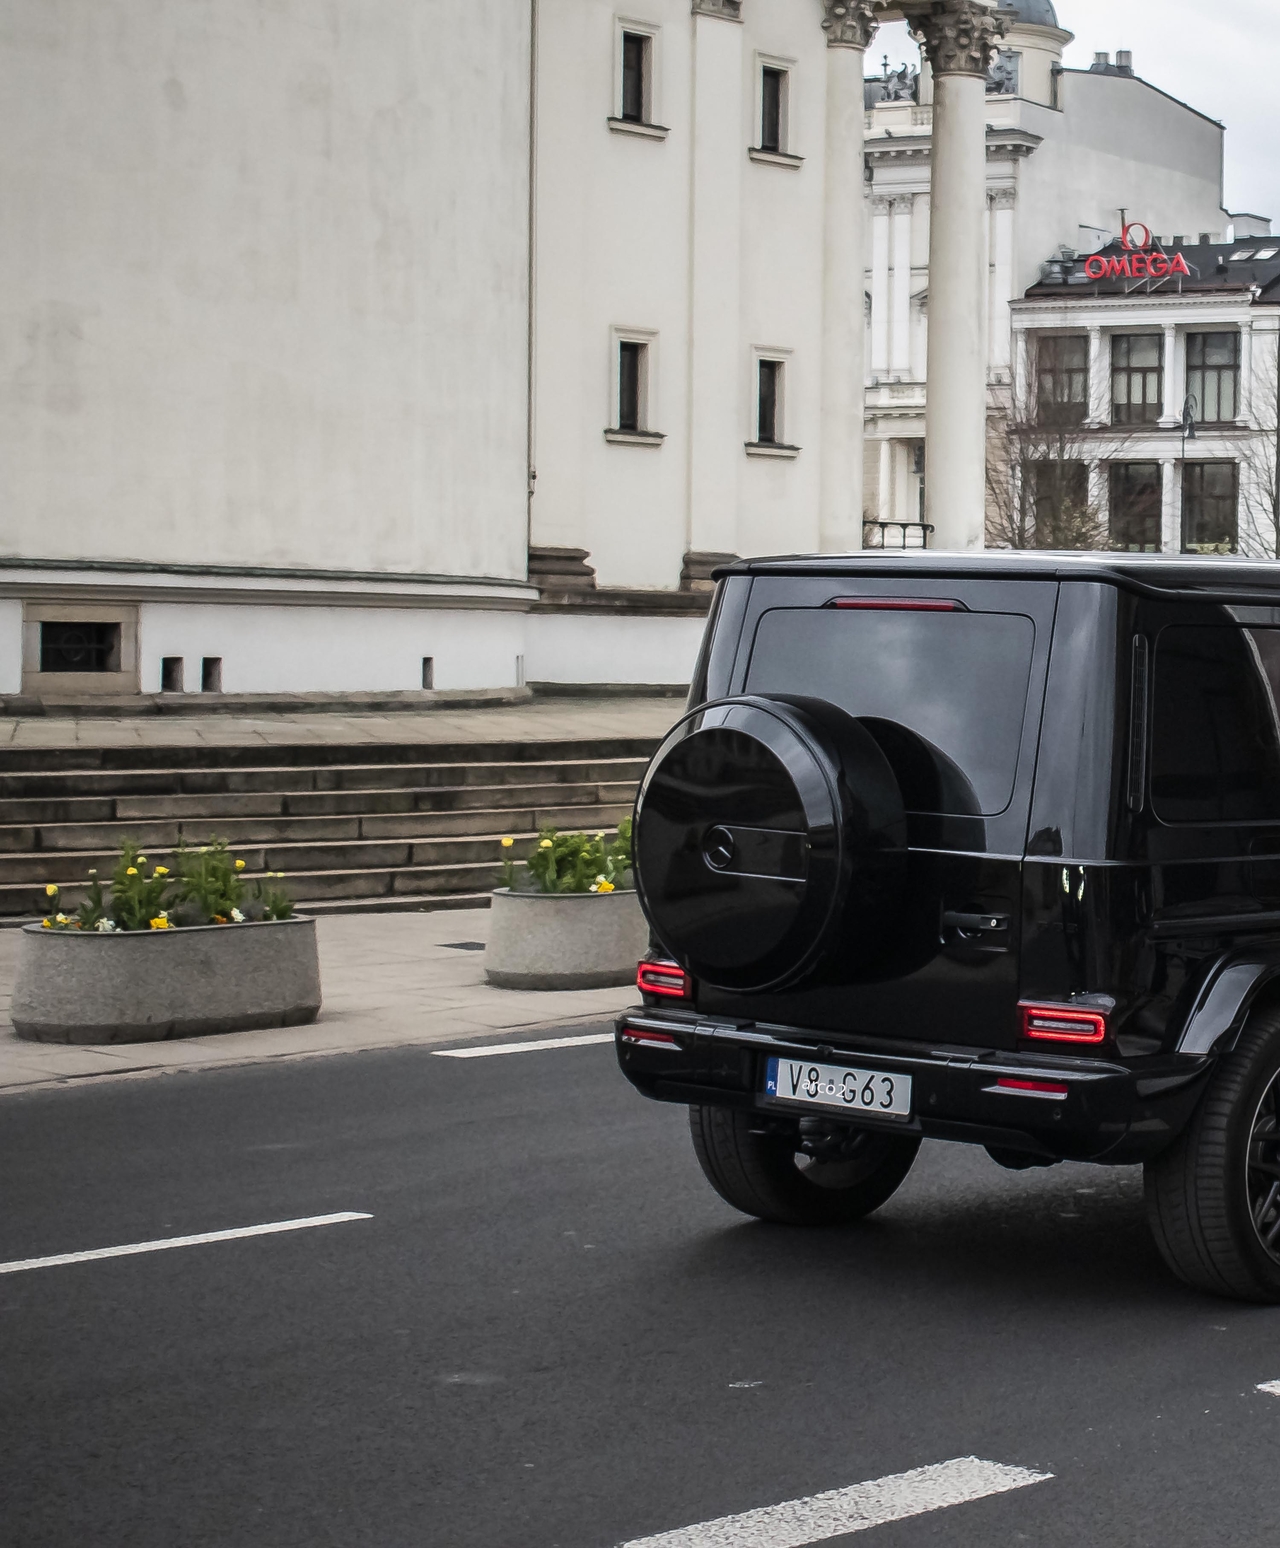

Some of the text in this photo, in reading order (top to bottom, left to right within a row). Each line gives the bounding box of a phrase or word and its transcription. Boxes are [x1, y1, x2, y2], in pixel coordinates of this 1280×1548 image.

[1084, 252, 1191, 279] OMEGA
[767, 1080, 777, 1090] PL
[789, 1063, 895, 1109] V8 G63
